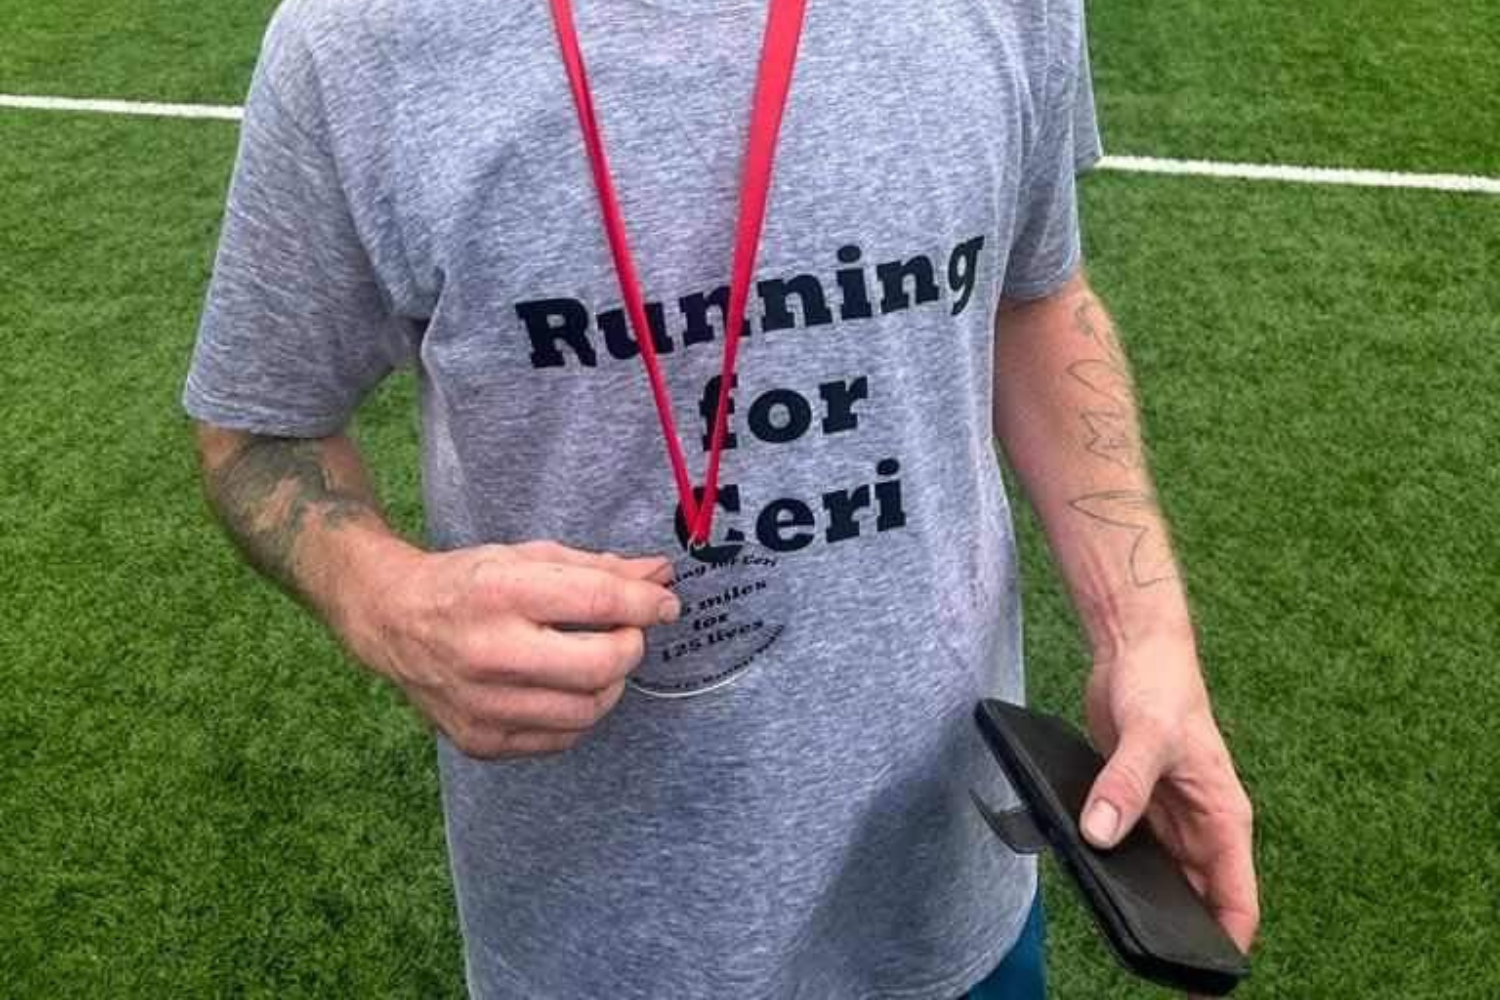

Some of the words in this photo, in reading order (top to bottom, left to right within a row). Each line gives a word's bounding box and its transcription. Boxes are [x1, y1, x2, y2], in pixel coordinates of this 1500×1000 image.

[515, 235, 986, 369] Running
[700, 374, 868, 452] for
[674, 458, 907, 563] Ceri
